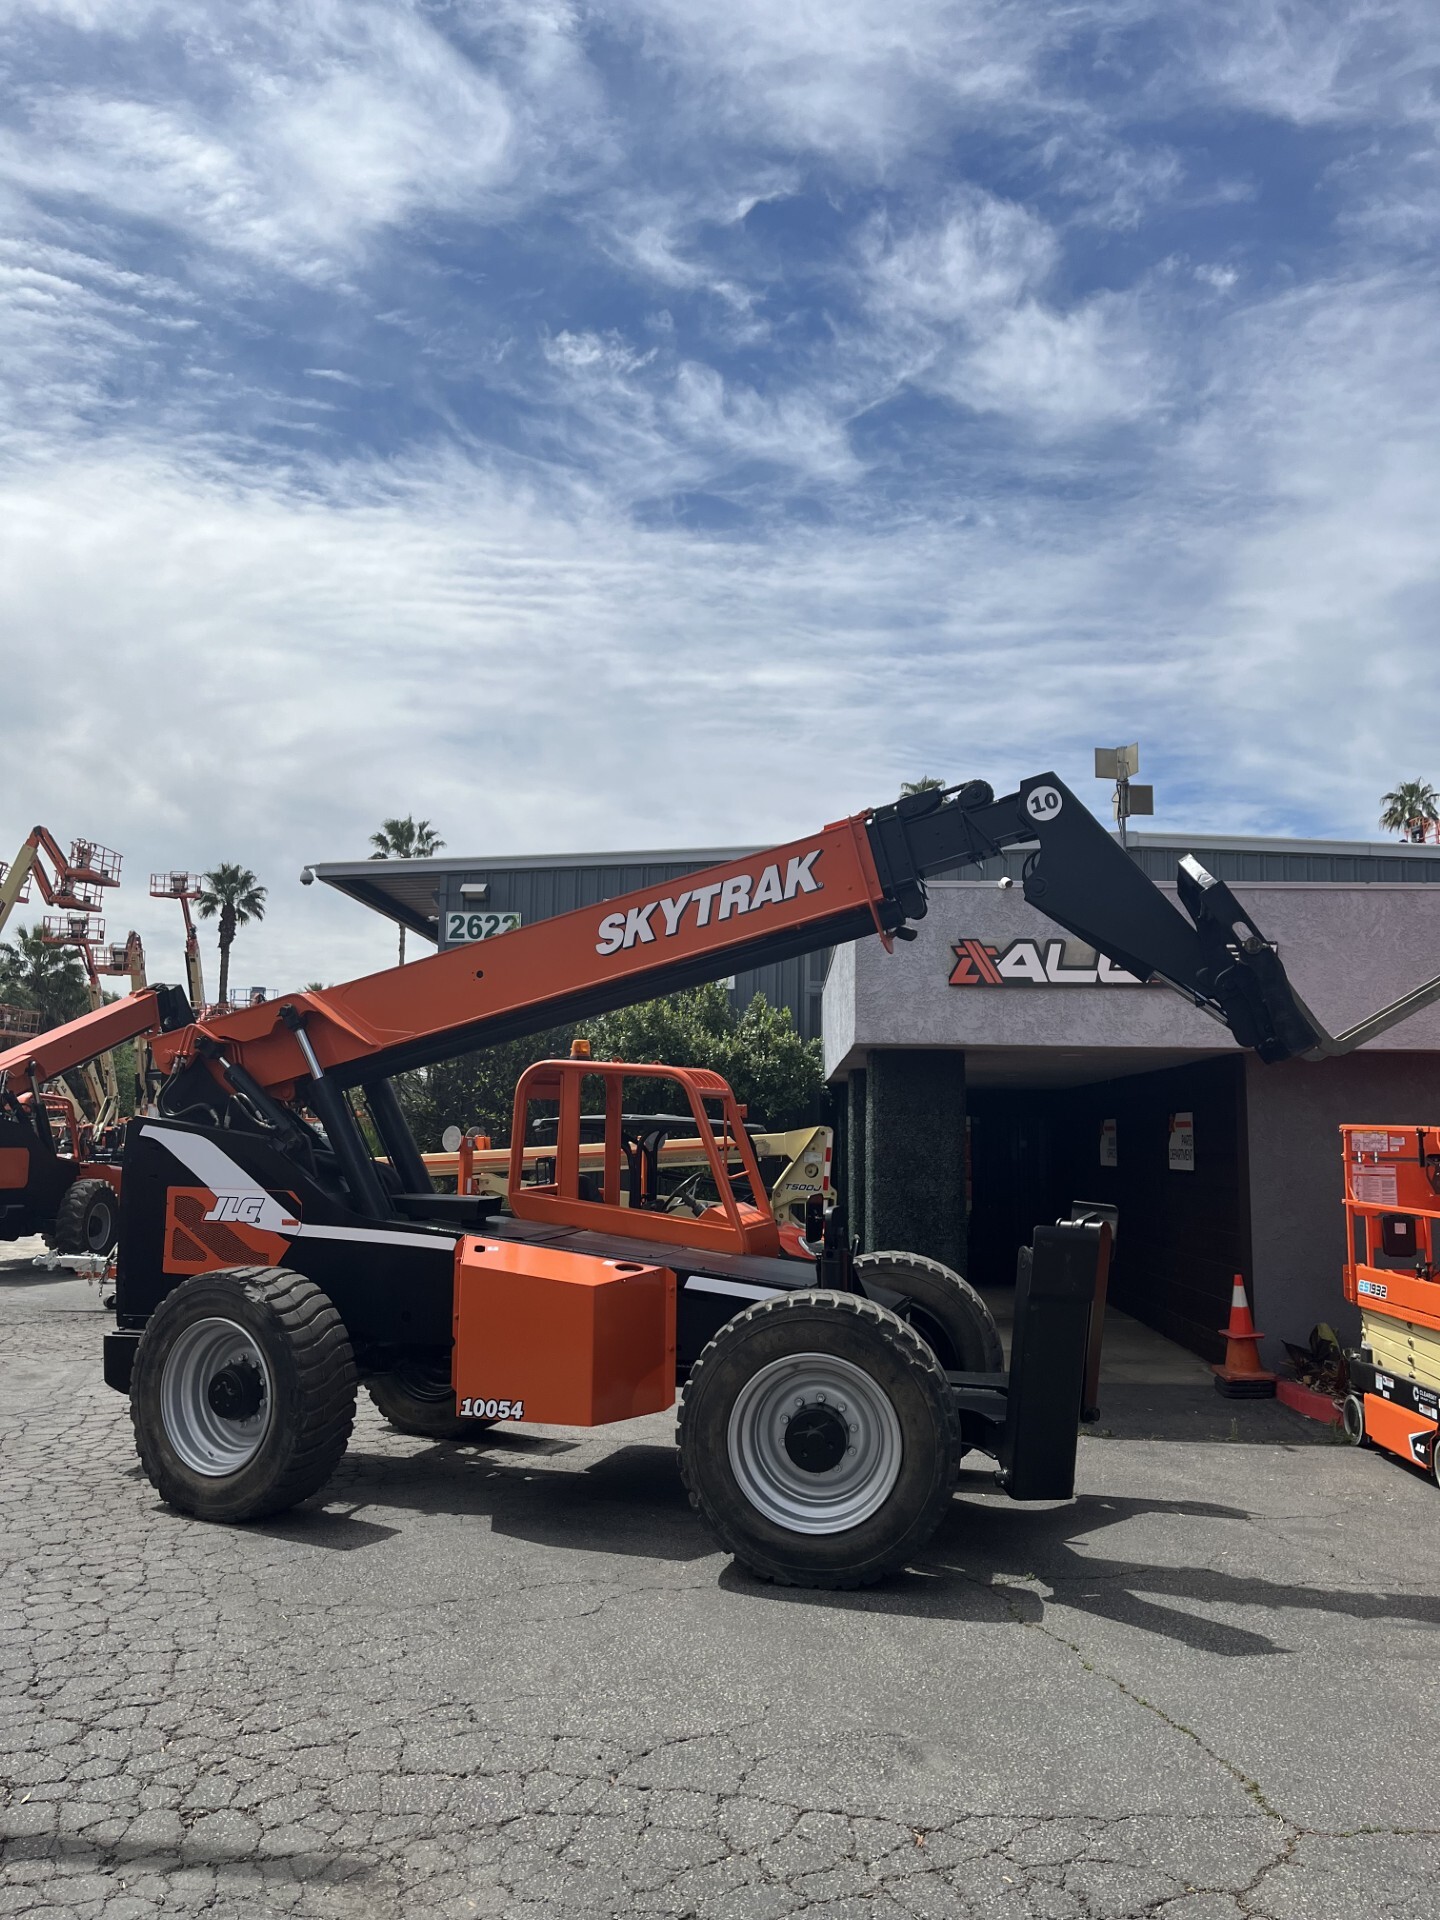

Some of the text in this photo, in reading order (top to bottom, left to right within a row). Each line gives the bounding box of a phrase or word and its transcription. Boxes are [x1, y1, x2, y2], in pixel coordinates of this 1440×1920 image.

[1031, 792, 1058, 814] 10
[595, 849, 824, 956] SKYTRAK
[785, 1183, 821, 1192] T500J
[203, 1196, 265, 1223] JLG
[460, 1397, 523, 1420] 10054
